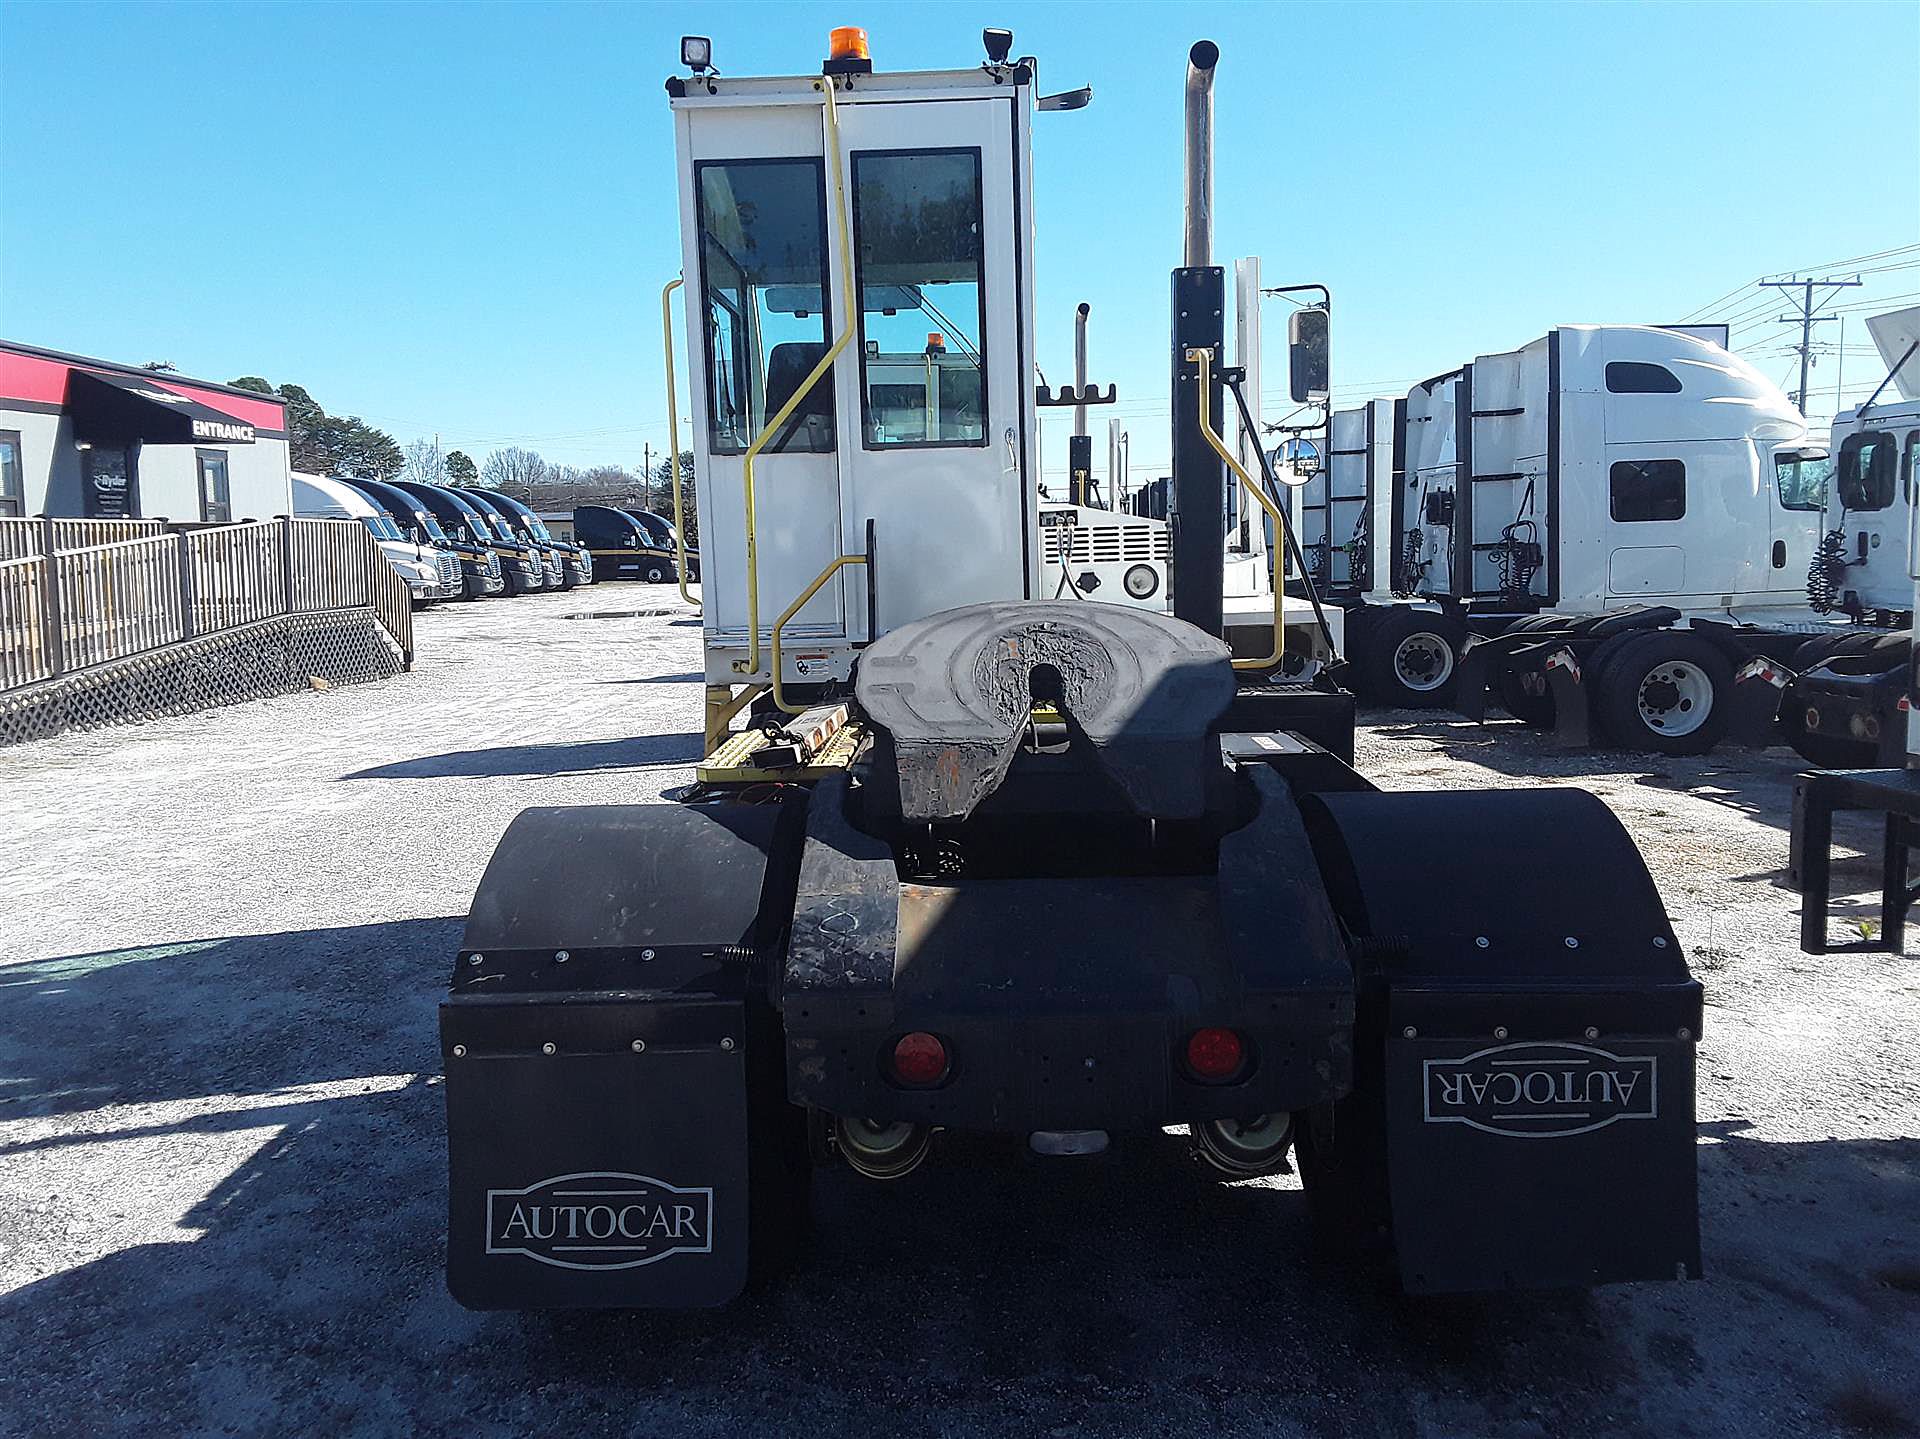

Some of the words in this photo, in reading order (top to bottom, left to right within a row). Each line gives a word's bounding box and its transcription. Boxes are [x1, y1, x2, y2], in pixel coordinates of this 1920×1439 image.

[193, 420, 255, 441] ENTRANCE
[1435, 1070, 1643, 1106] AUTOCAR
[500, 1202, 701, 1239] AUTOCAR
